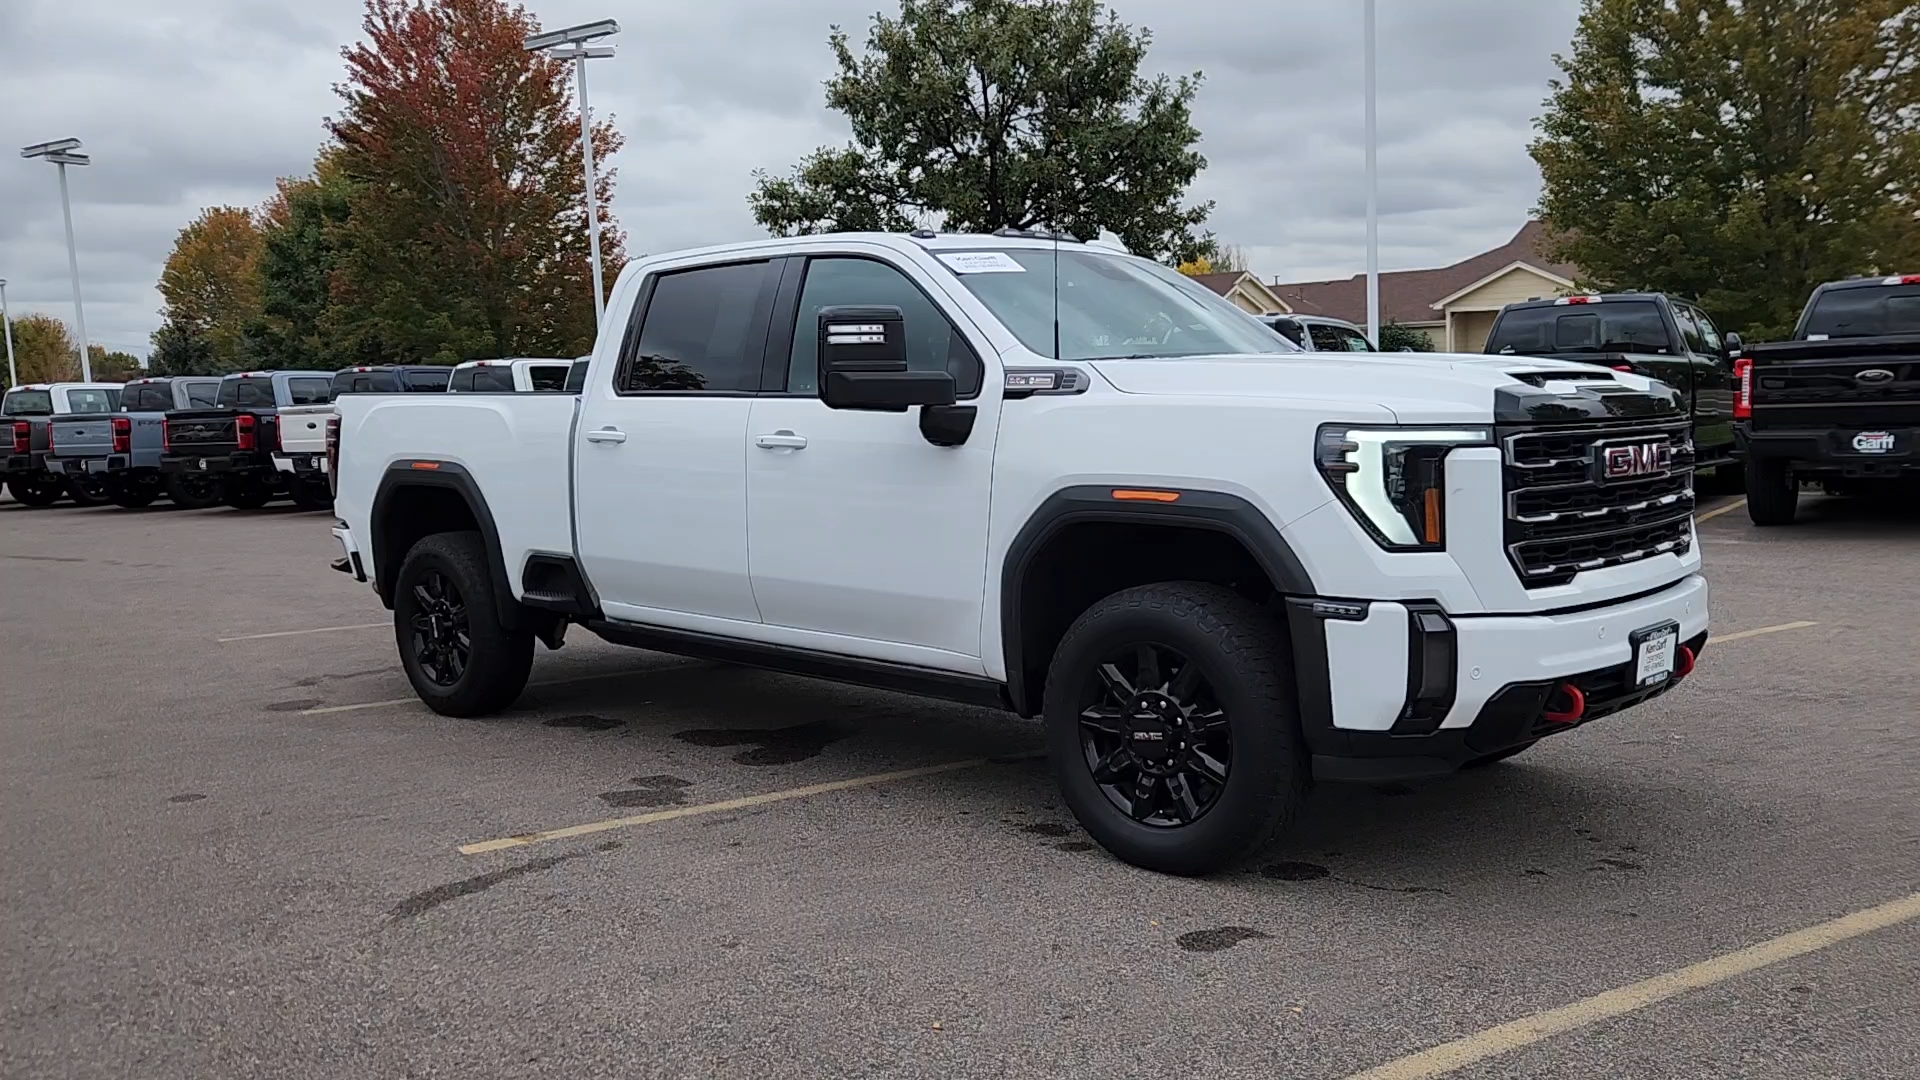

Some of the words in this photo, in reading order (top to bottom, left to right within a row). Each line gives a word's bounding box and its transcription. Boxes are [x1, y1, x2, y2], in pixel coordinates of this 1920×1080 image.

[1852, 434, 1895, 450] Garff
[1604, 443, 1671, 479] GMC
[1133, 731, 1163, 740] GMC
